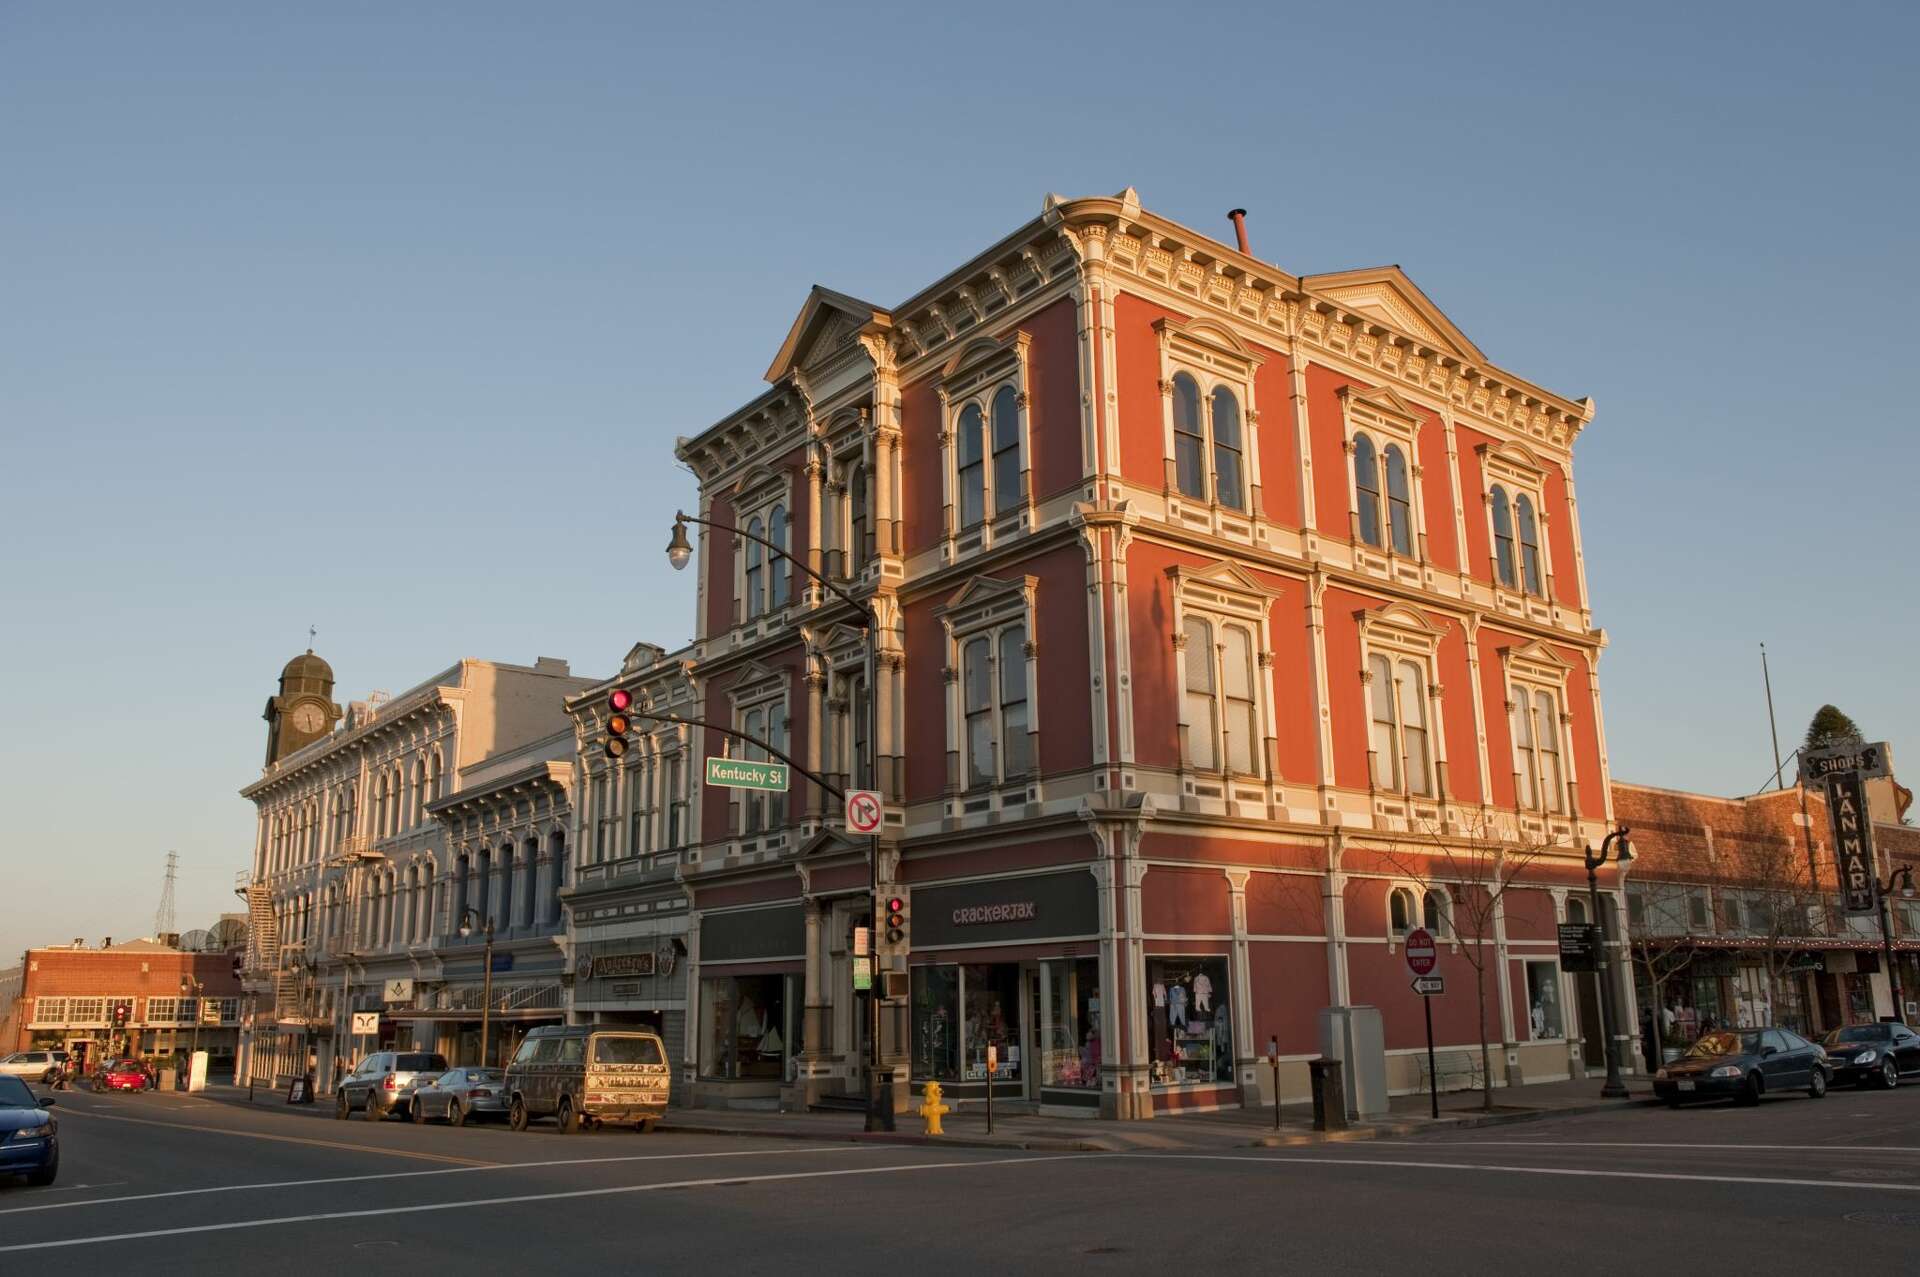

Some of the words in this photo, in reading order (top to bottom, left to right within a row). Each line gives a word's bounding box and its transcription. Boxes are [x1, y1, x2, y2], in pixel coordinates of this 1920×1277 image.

[1820, 756, 1865, 773] SHOPS
[712, 763, 766, 785] Kentucky
[770, 770, 783, 784] St
[1420, 938, 1431, 946] NOT
[1412, 959, 1432, 968] ENTER
